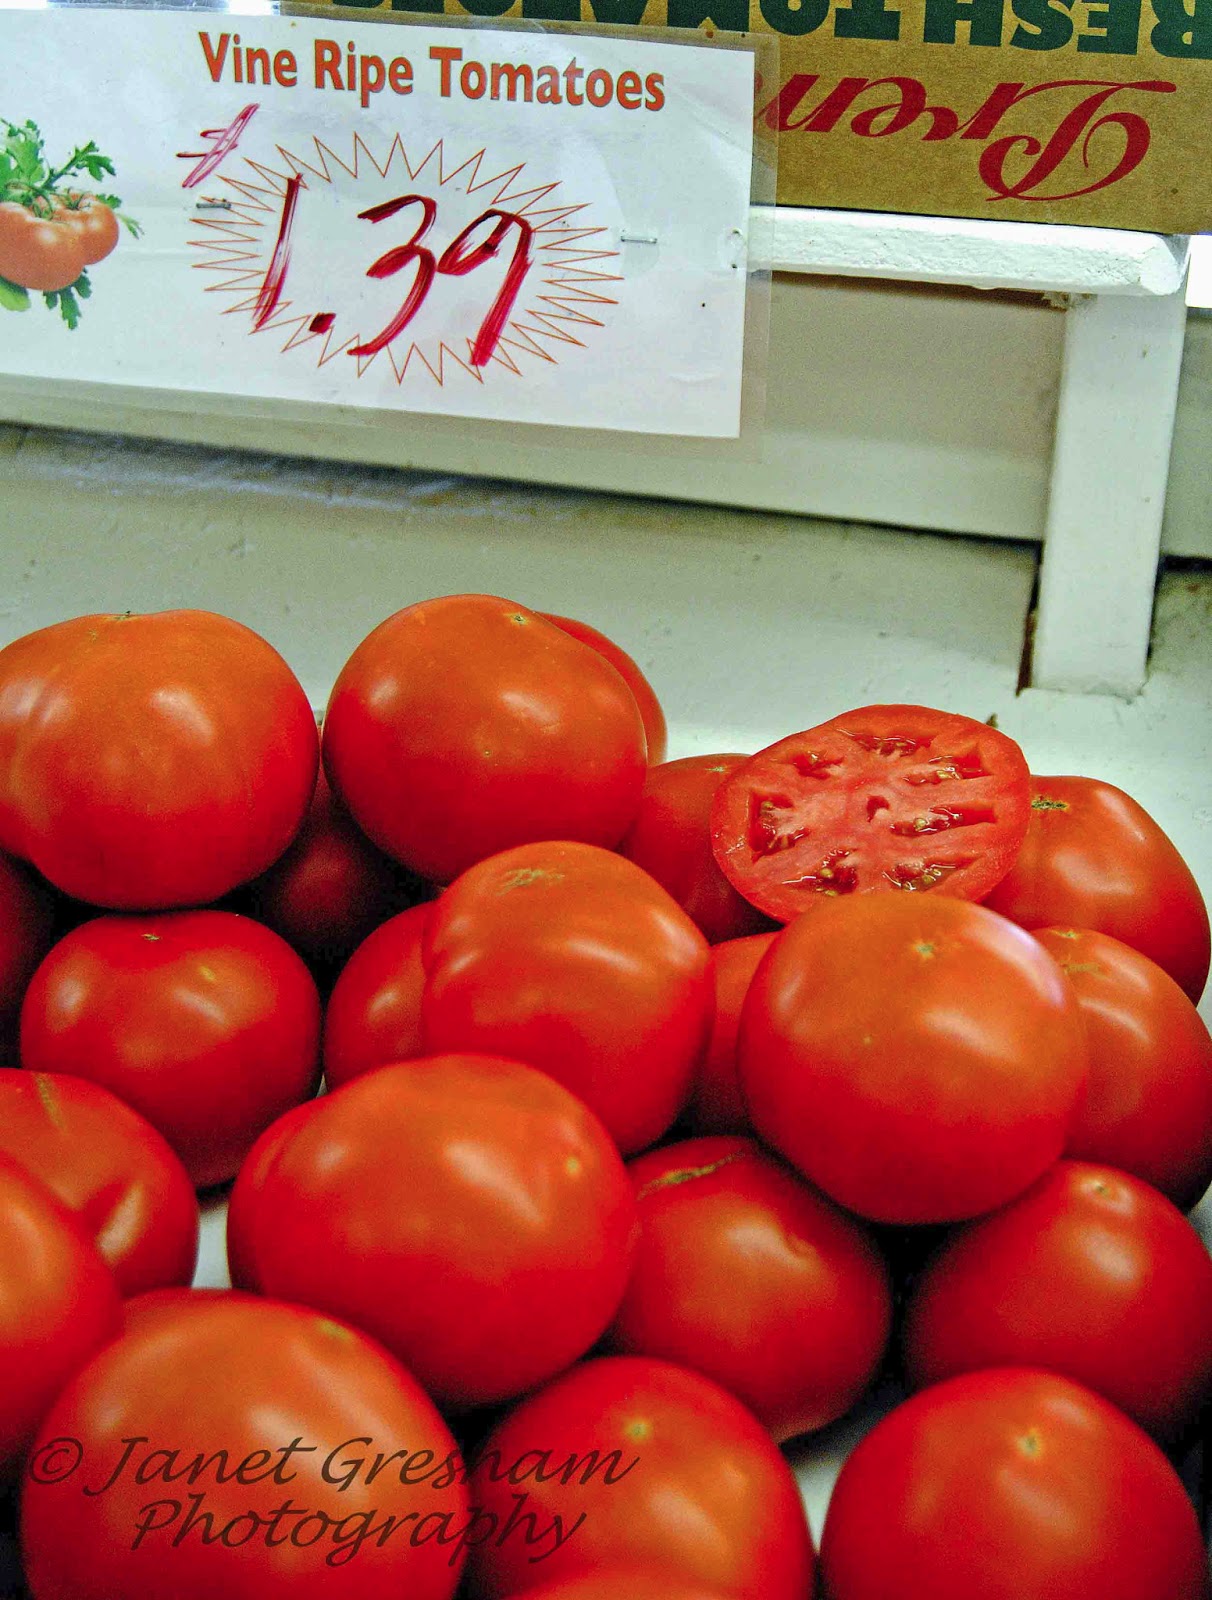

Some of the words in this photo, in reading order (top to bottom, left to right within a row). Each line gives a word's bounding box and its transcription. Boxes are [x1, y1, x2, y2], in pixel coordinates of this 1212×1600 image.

[198, 32, 298, 87] Vine
[314, 40, 414, 107] Ripe
[429, 47, 665, 111] Tomatoes
[251, 172, 535, 367] 1.39
